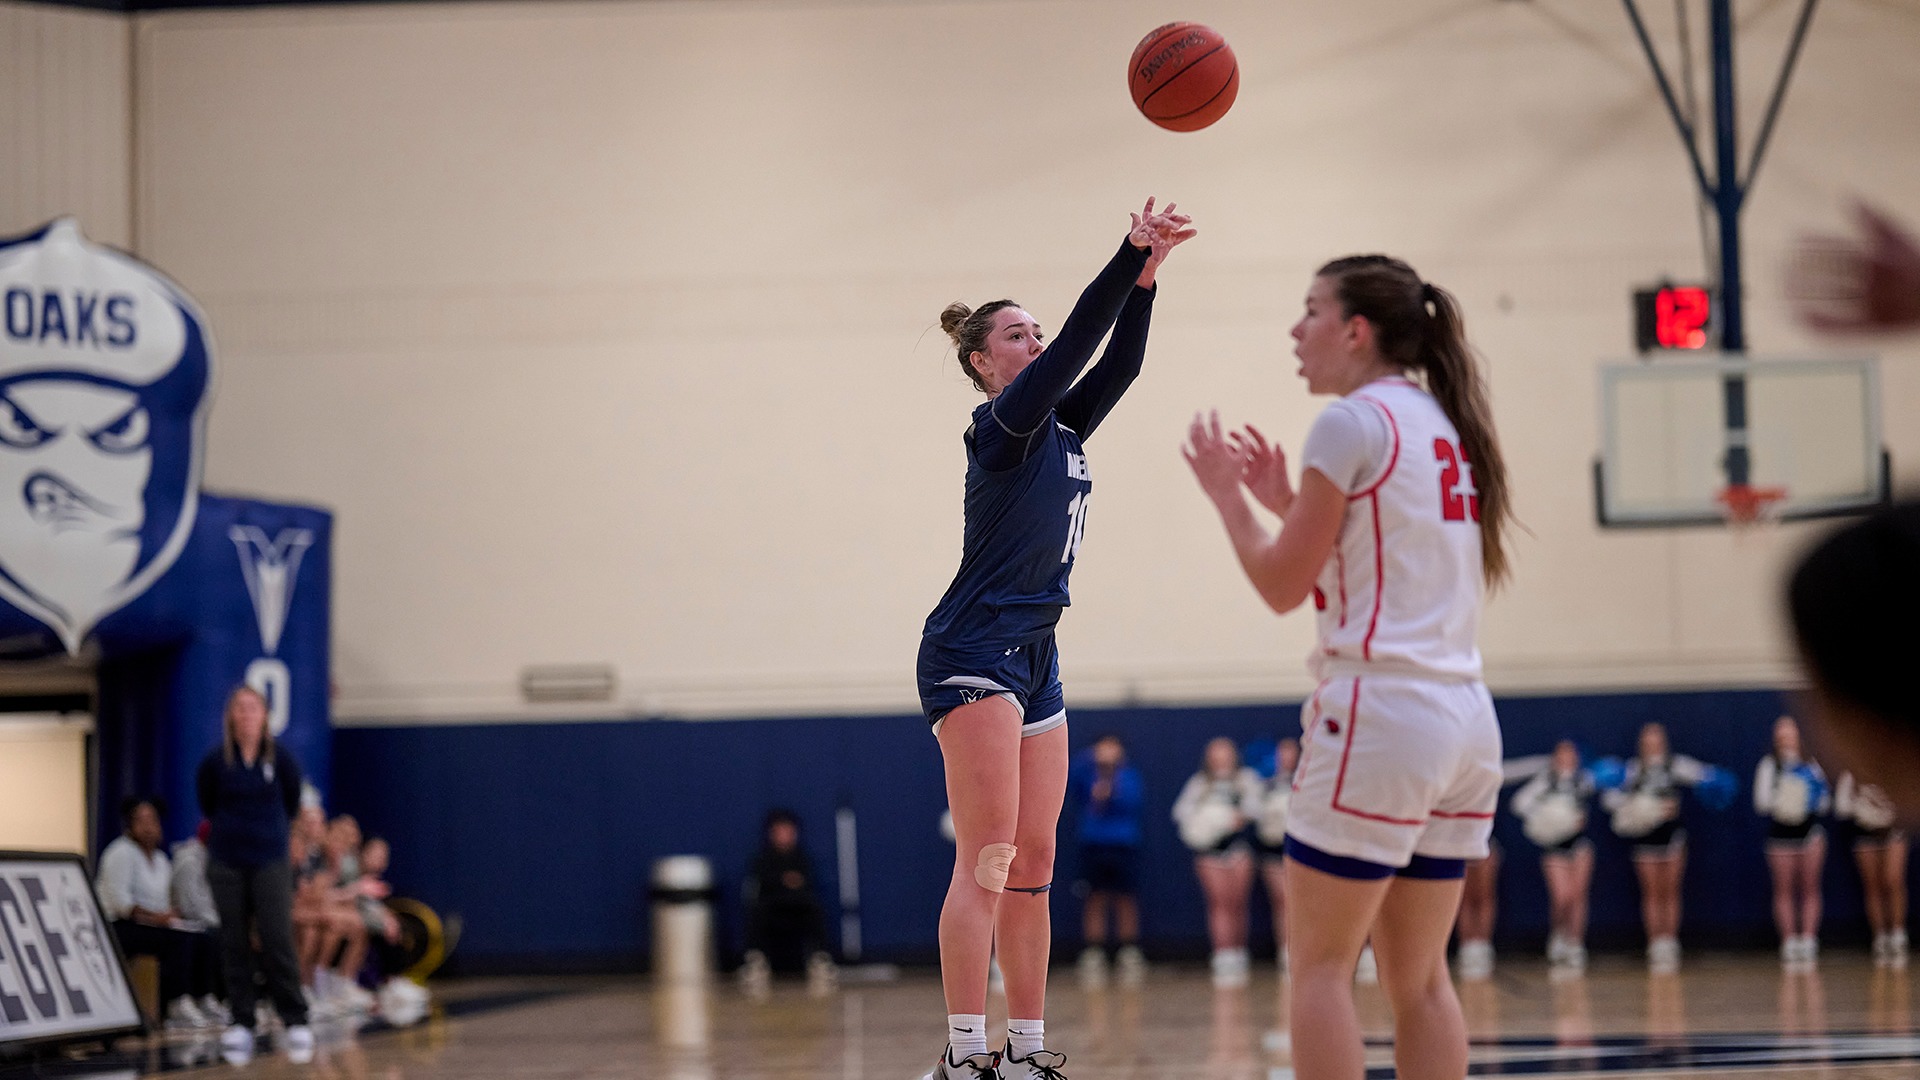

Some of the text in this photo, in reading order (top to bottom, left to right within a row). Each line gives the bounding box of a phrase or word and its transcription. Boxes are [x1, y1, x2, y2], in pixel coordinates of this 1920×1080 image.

[1140, 31, 1207, 84] SPALDING
[5, 287, 137, 347] OAKS
[1066, 451, 1092, 481] ME
